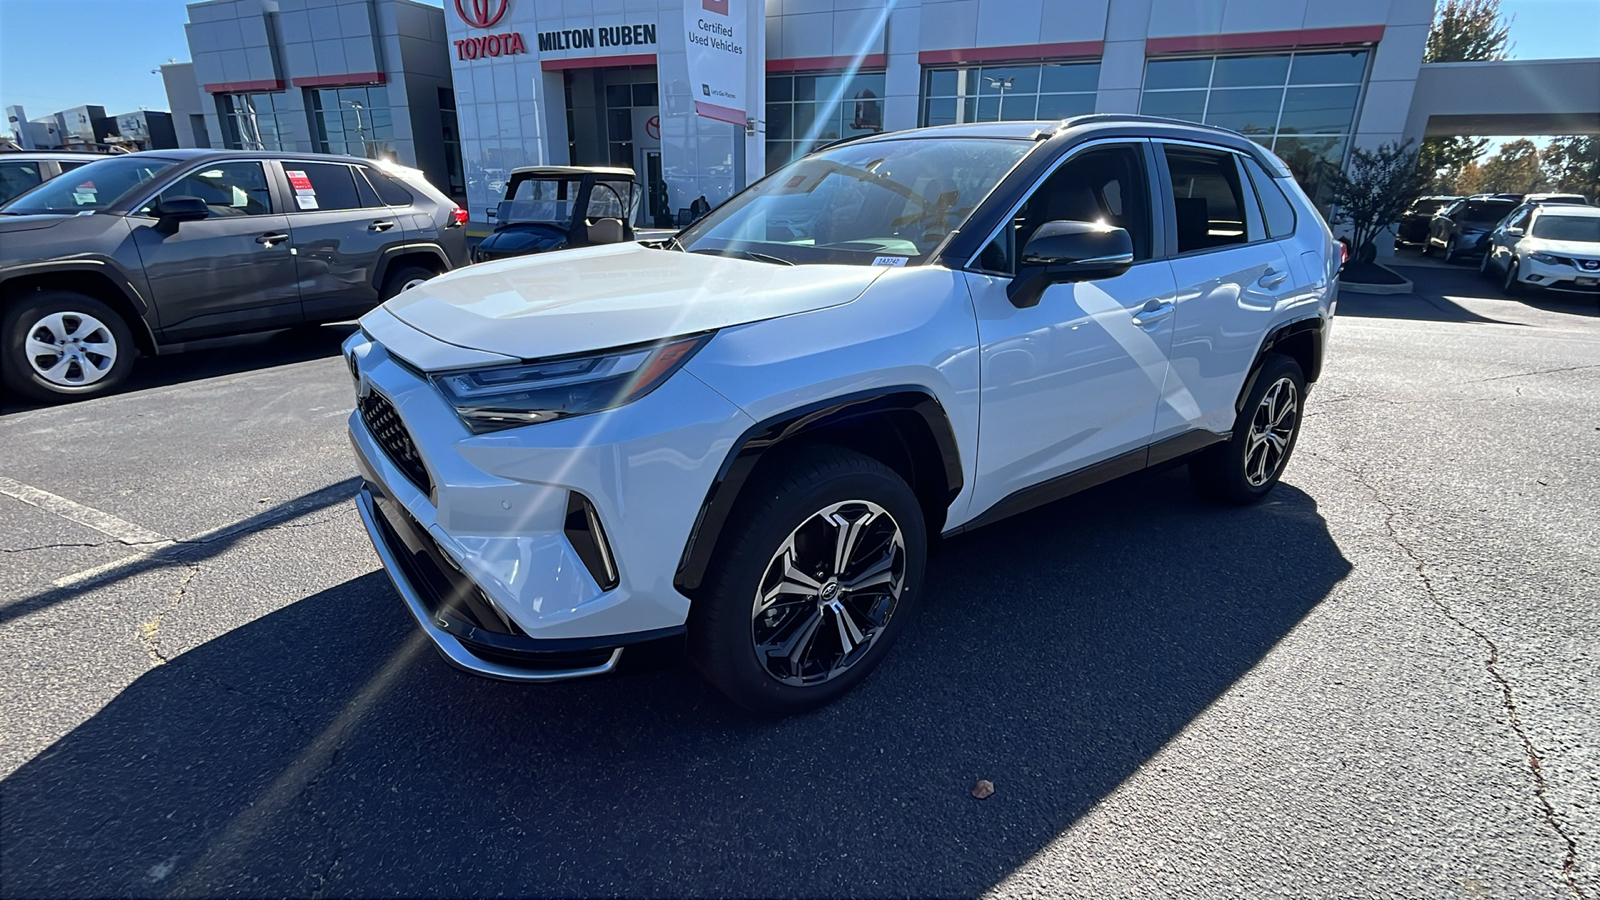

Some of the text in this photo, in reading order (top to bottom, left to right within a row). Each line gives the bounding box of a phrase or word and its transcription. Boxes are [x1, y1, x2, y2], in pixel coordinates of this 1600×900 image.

[538, 24, 657, 52] MILTON RUBEN
[698, 19, 733, 37] Certified
[453, 32, 525, 61] TOYOTA
[689, 31, 743, 54] Used Vehicles
